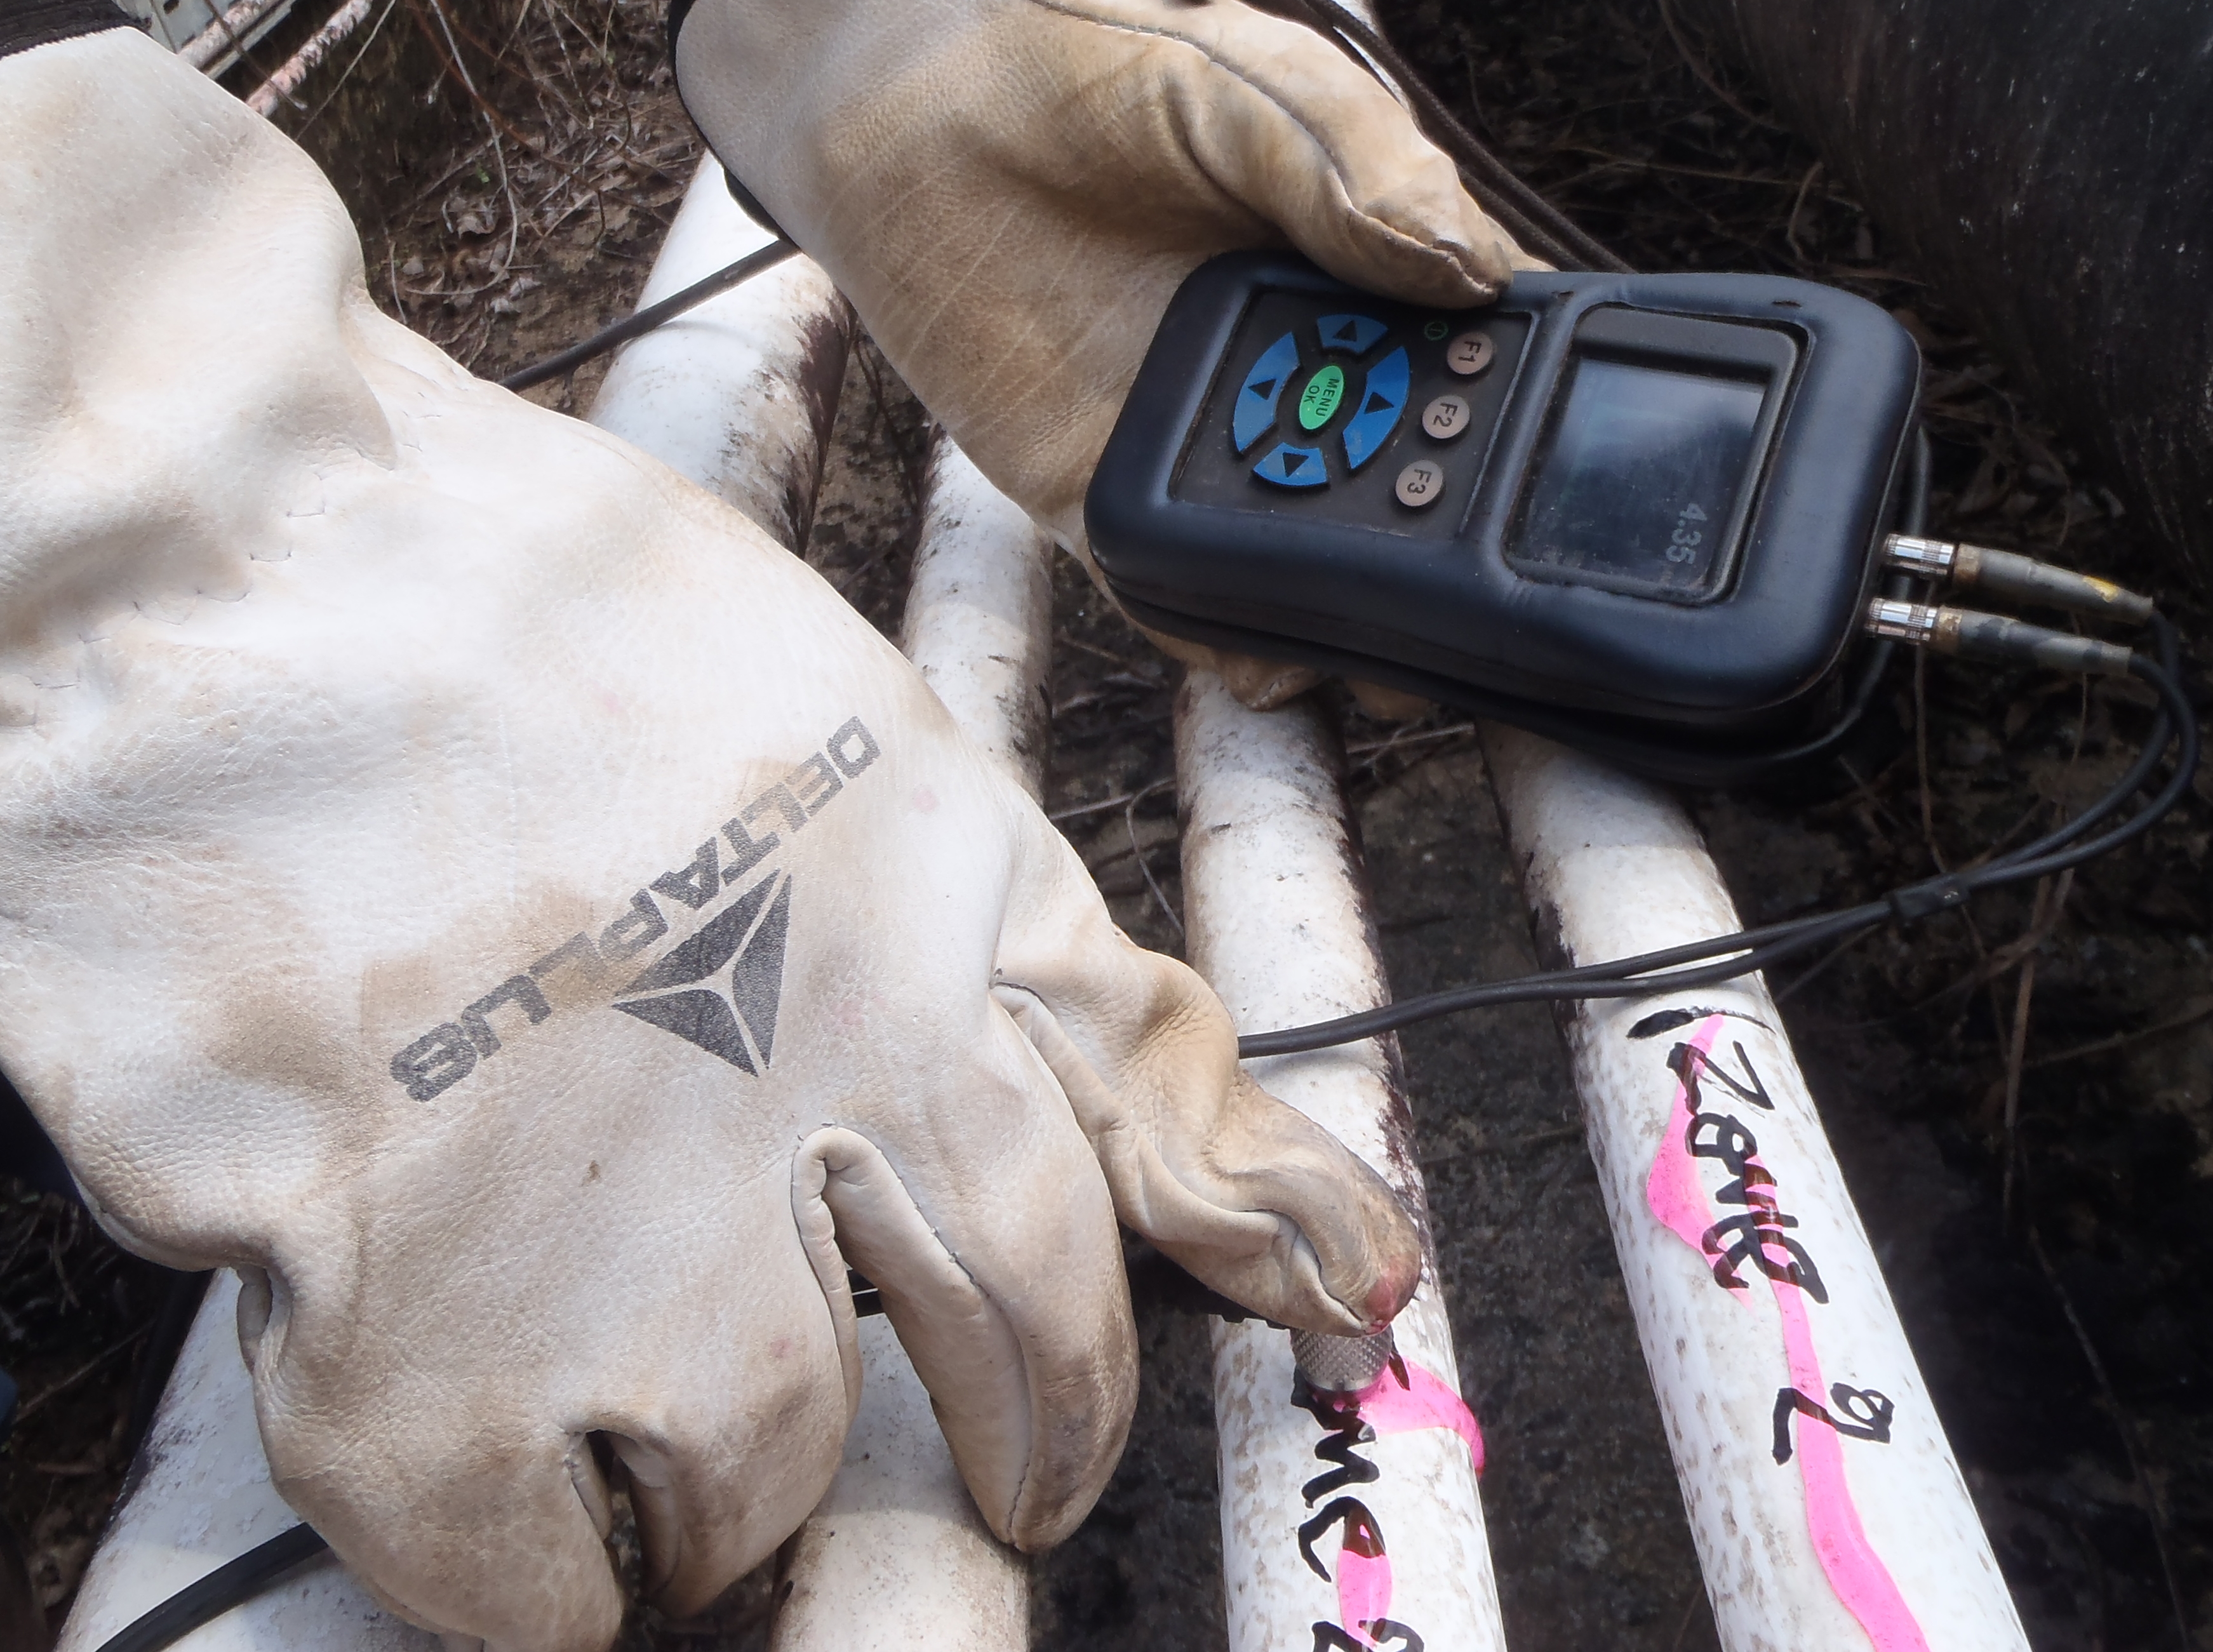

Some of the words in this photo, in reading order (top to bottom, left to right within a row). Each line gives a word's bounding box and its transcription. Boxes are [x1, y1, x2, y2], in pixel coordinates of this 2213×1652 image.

[1458, 340, 1482, 363] F1
[1304, 385, 1320, 404] OK
[1316, 378, 1340, 417] MENU
[1433, 402, 1458, 428] F2
[1407, 469, 1432, 495] F3
[1666, 503, 1708, 564] 4.35
